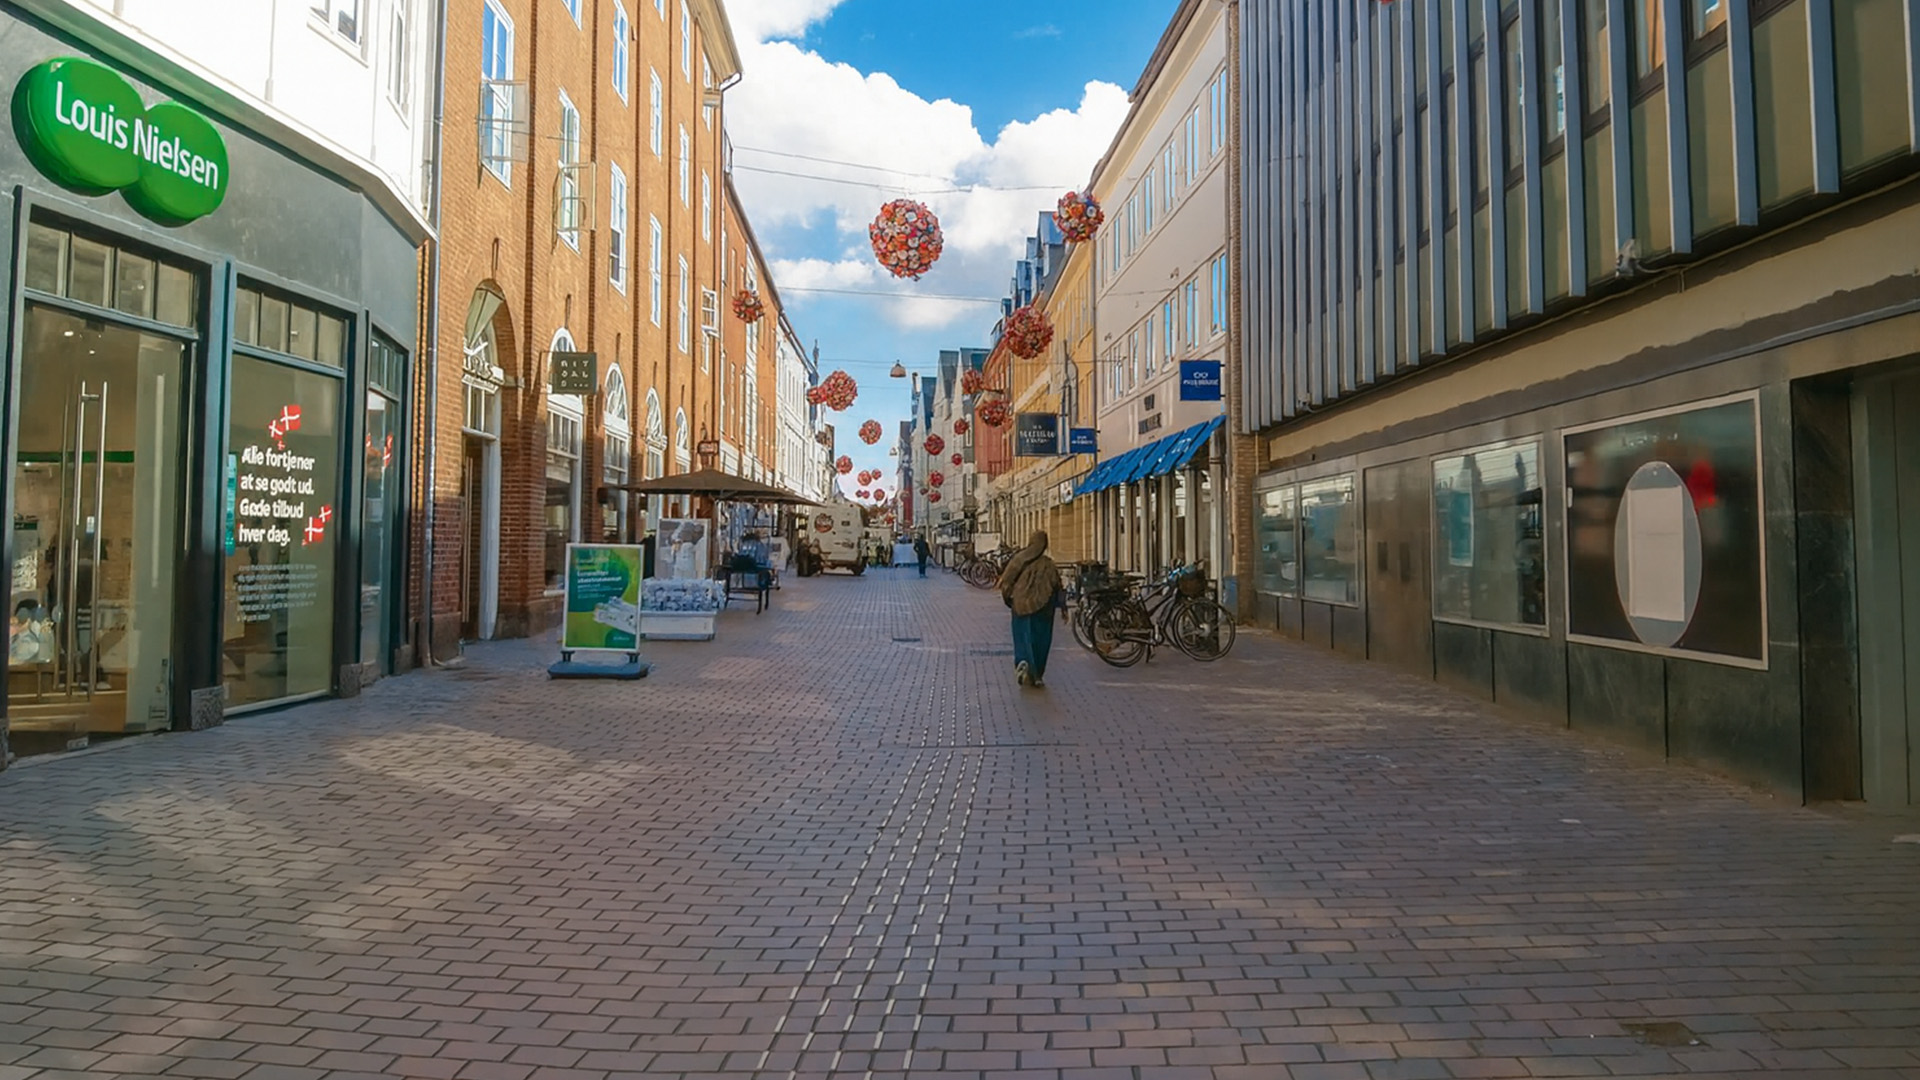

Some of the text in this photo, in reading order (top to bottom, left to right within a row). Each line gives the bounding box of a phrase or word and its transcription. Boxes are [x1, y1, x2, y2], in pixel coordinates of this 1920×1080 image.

[55, 81, 218, 190] Louis Nielsen
[241, 445, 315, 472] Alle fortjener
[240, 473, 315, 496] at se godt ud.
[240, 498, 304, 519] Gode tilbud
[238, 523, 291, 547] hver dag.
